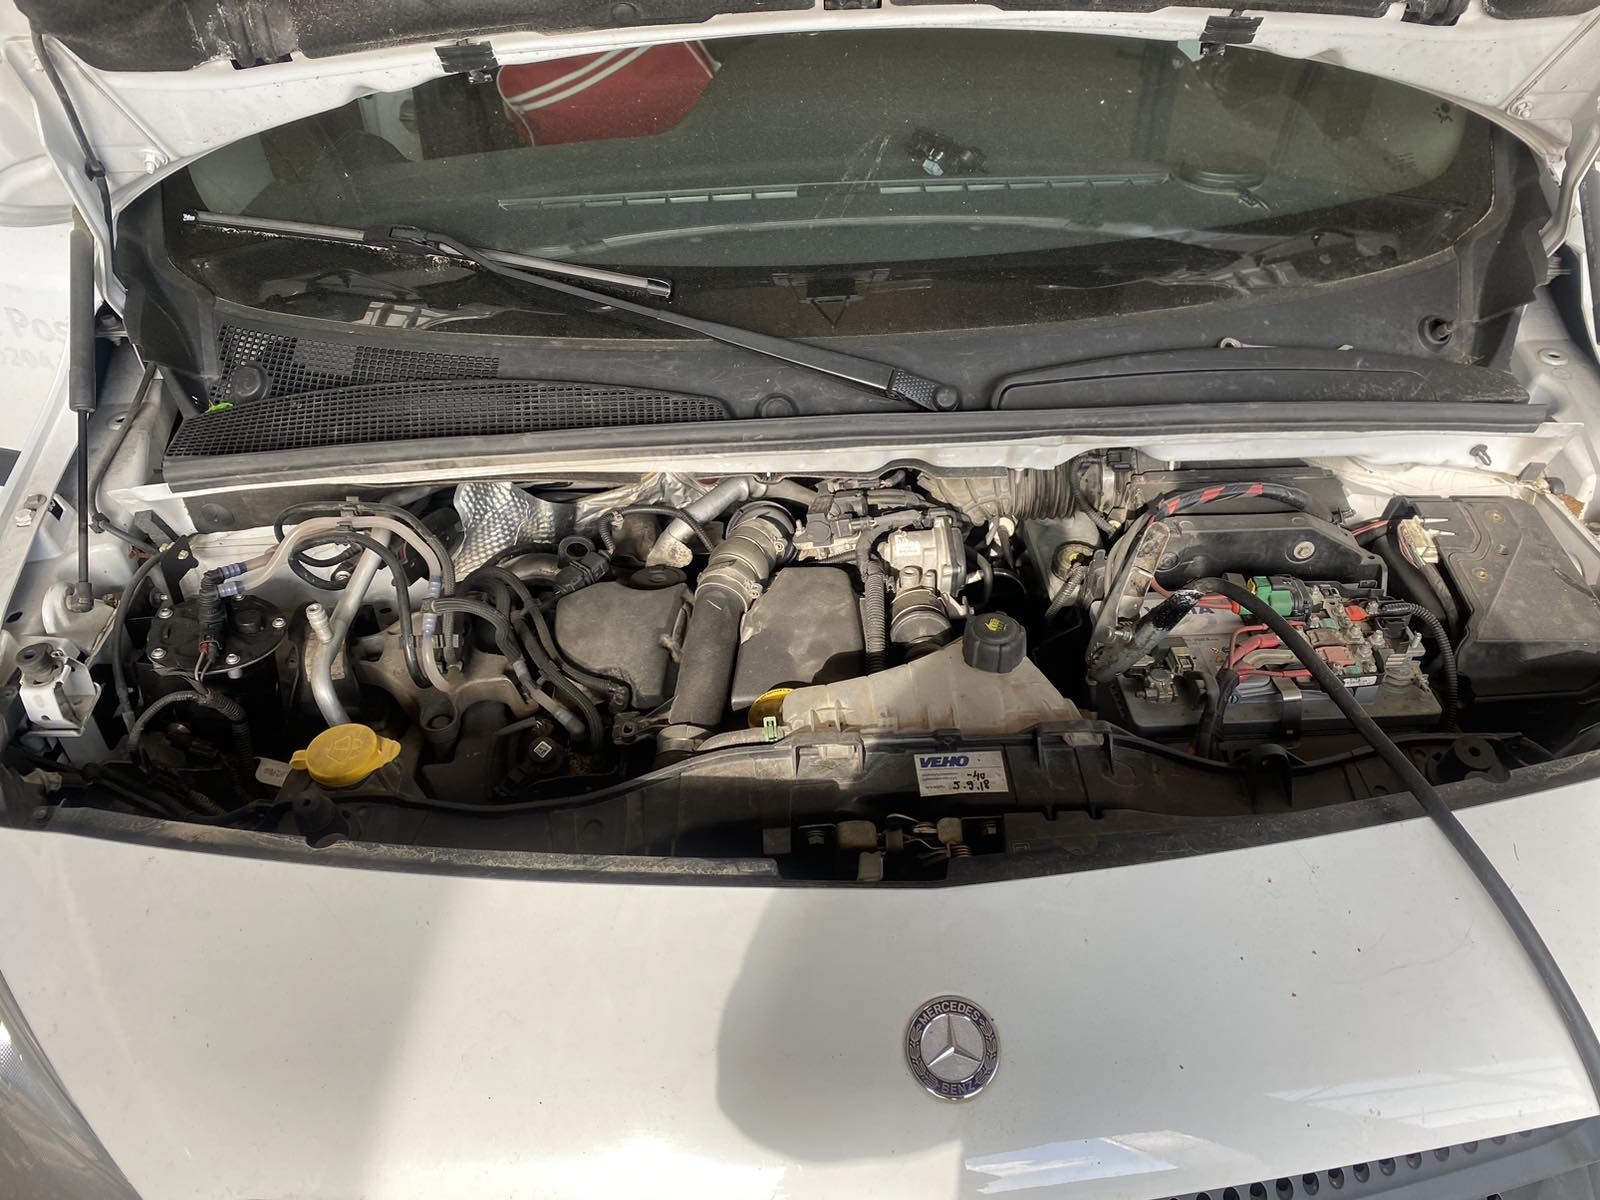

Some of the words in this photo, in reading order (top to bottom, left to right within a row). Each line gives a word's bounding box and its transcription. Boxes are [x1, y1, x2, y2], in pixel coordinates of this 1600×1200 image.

[919, 756, 969, 768] VEHO
[919, 1001, 981, 1025] MERCEDES
[941, 1083, 976, 1095] BENZ
